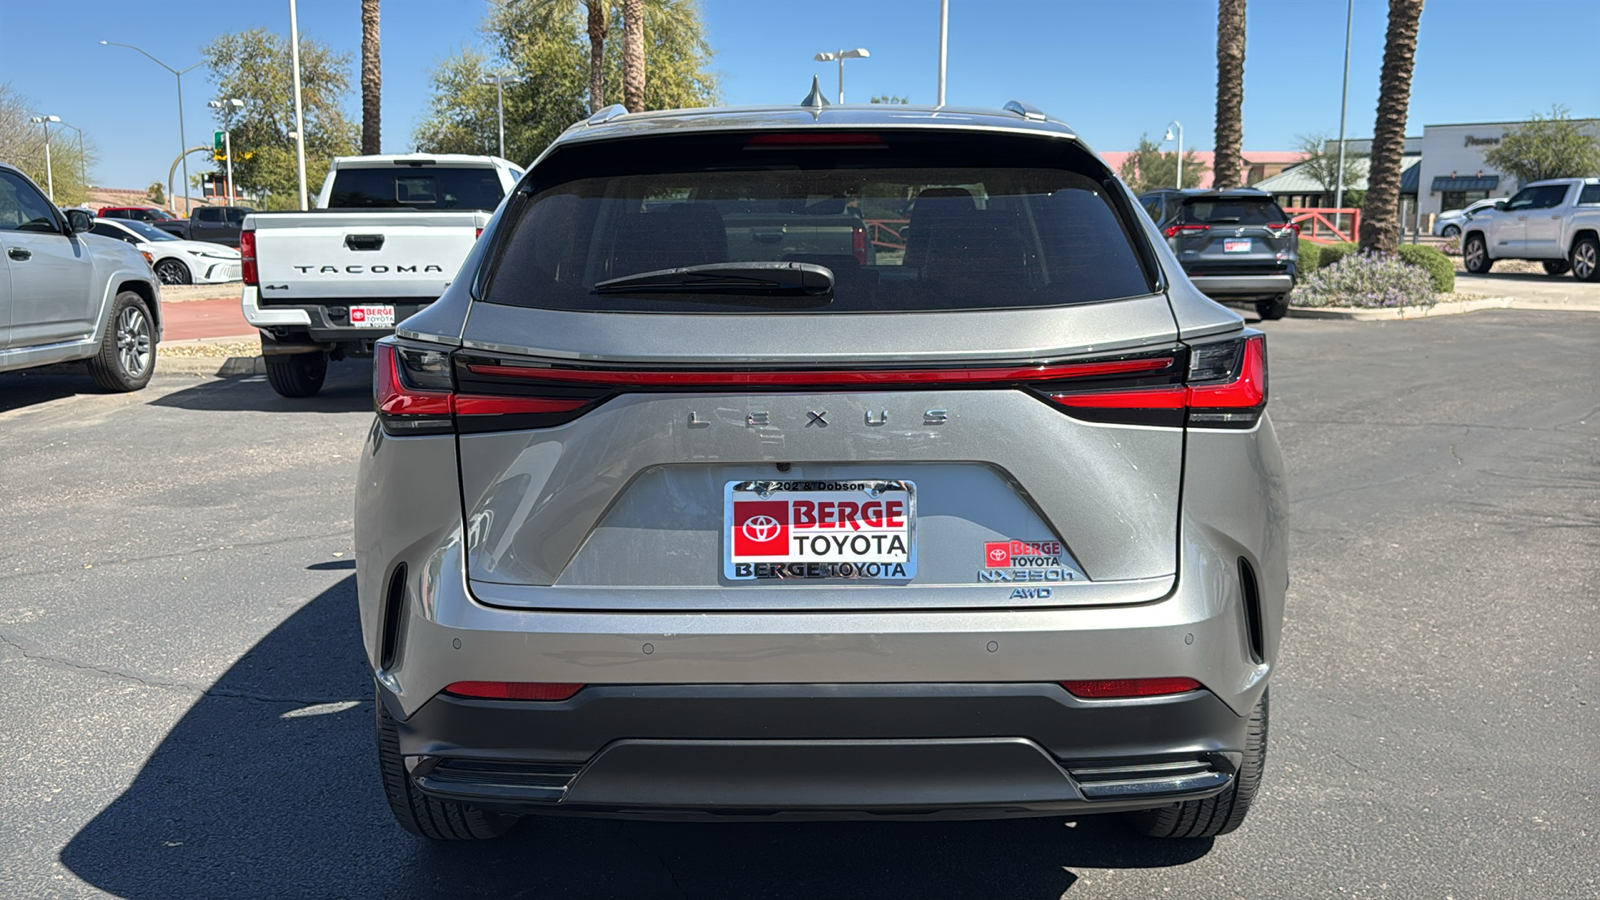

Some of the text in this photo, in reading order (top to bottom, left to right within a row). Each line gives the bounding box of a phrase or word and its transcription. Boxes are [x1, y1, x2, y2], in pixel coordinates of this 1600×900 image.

[293, 265, 443, 273] TACOMA
[366, 308, 393, 316] BERGE
[687, 409, 948, 428] LEXUS
[777, 481, 865, 491] 202 & Dobson
[792, 500, 904, 532] BERGE
[793, 535, 907, 555] TOYOTA
[1011, 540, 1060, 556] BERGE
[1011, 557, 1060, 567] TOYOTA
[735, 562, 907, 578] BERGE TOYOTA
[1009, 587, 1053, 599] AWD
